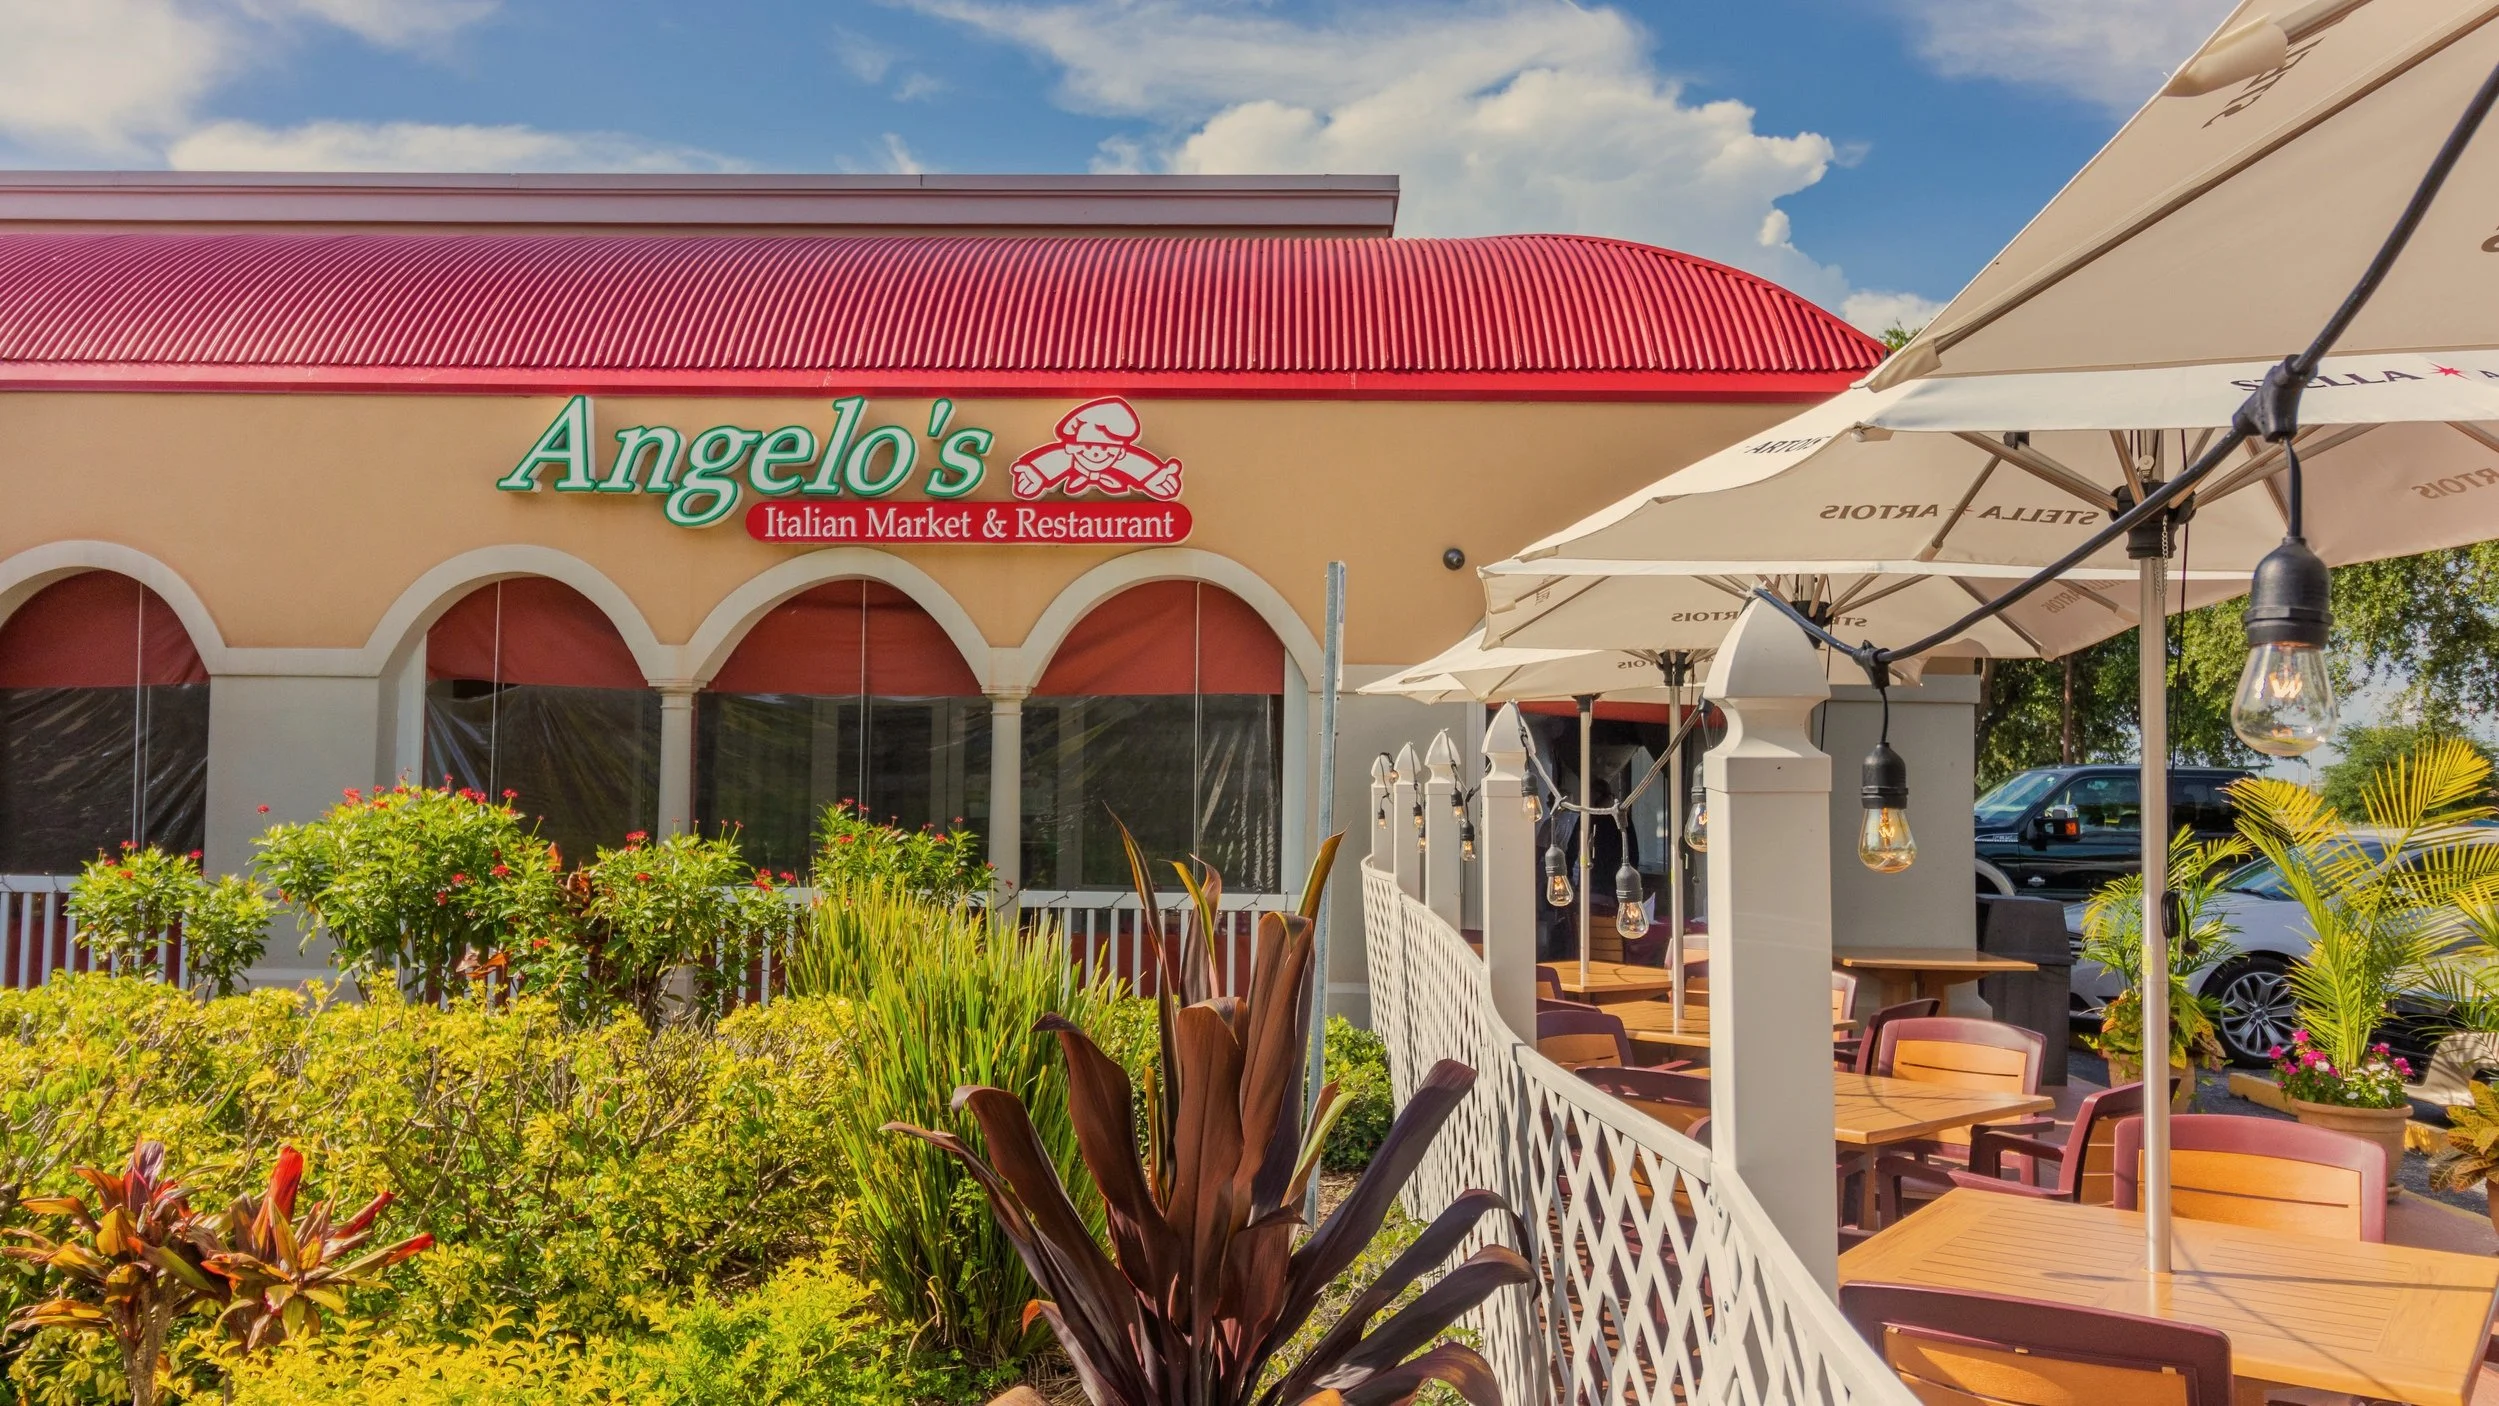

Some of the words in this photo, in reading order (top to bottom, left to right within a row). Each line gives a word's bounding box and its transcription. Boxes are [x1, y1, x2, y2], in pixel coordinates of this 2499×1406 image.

[2231, 369, 2425, 392] SLLA
[496, 395, 995, 527] Angelo's
[765, 507, 857, 538] Italian
[866, 507, 972, 539] Market
[982, 508, 1007, 539] &
[1016, 508, 1174, 539] Restaurant
